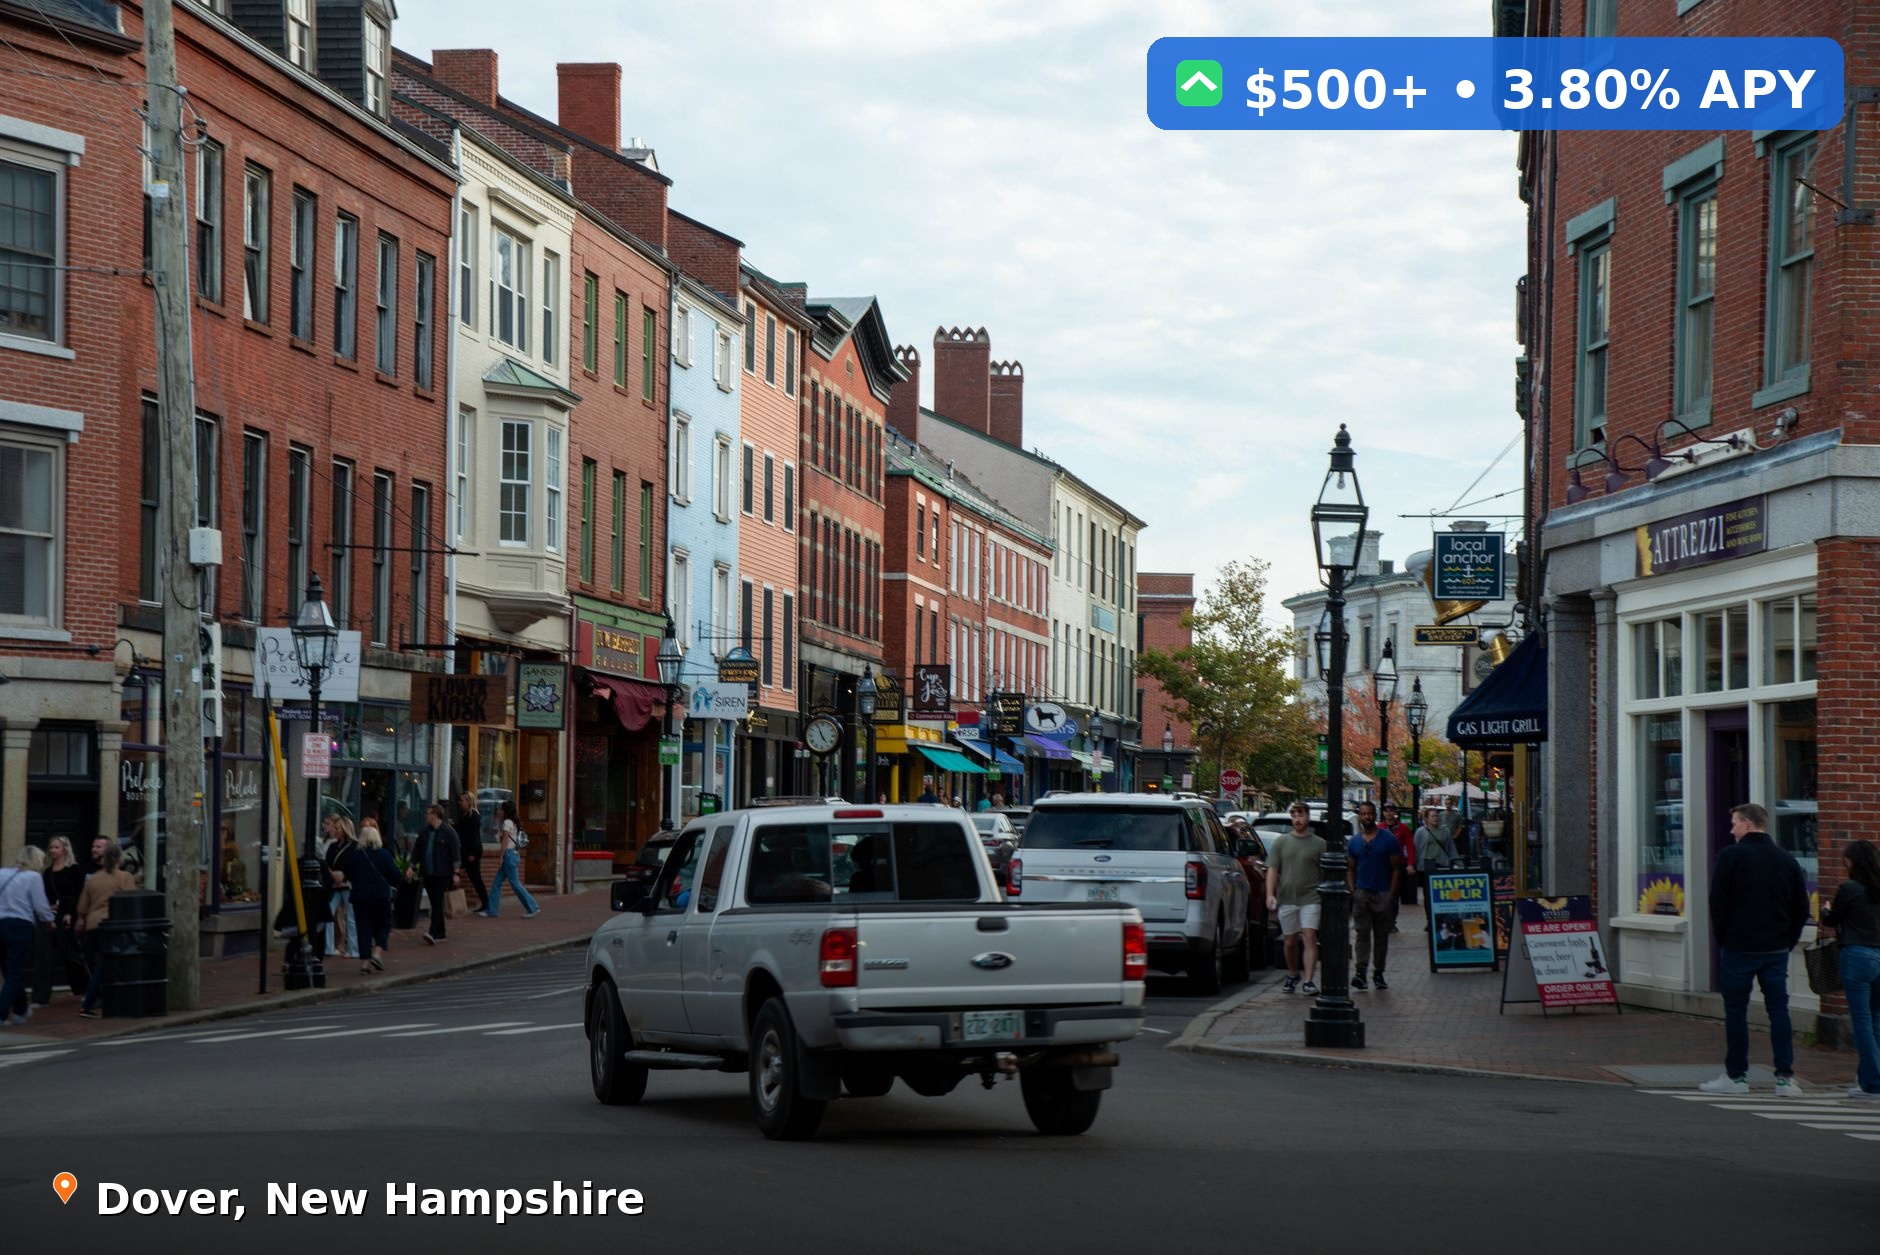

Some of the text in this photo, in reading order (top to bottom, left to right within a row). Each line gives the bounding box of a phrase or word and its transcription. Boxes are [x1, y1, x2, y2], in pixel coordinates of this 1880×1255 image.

[1451, 537, 1486, 551] local
[1654, 515, 1724, 565] ATTREZZI
[1443, 551, 1495, 564] anchor
[429, 678, 487, 696] FLOWER
[428, 695, 488, 721] KIOSK
[714, 697, 745, 708] SIREN
[1457, 718, 1542, 736] GAS LIGHT GRILL
[1221, 776, 1241, 785] STOP
[1432, 878, 1487, 889] HAPPY
[1527, 924, 1542, 933] WE
[1543, 923, 1562, 932] ARE
[1544, 982, 1608, 994] ORDER ONLINE
